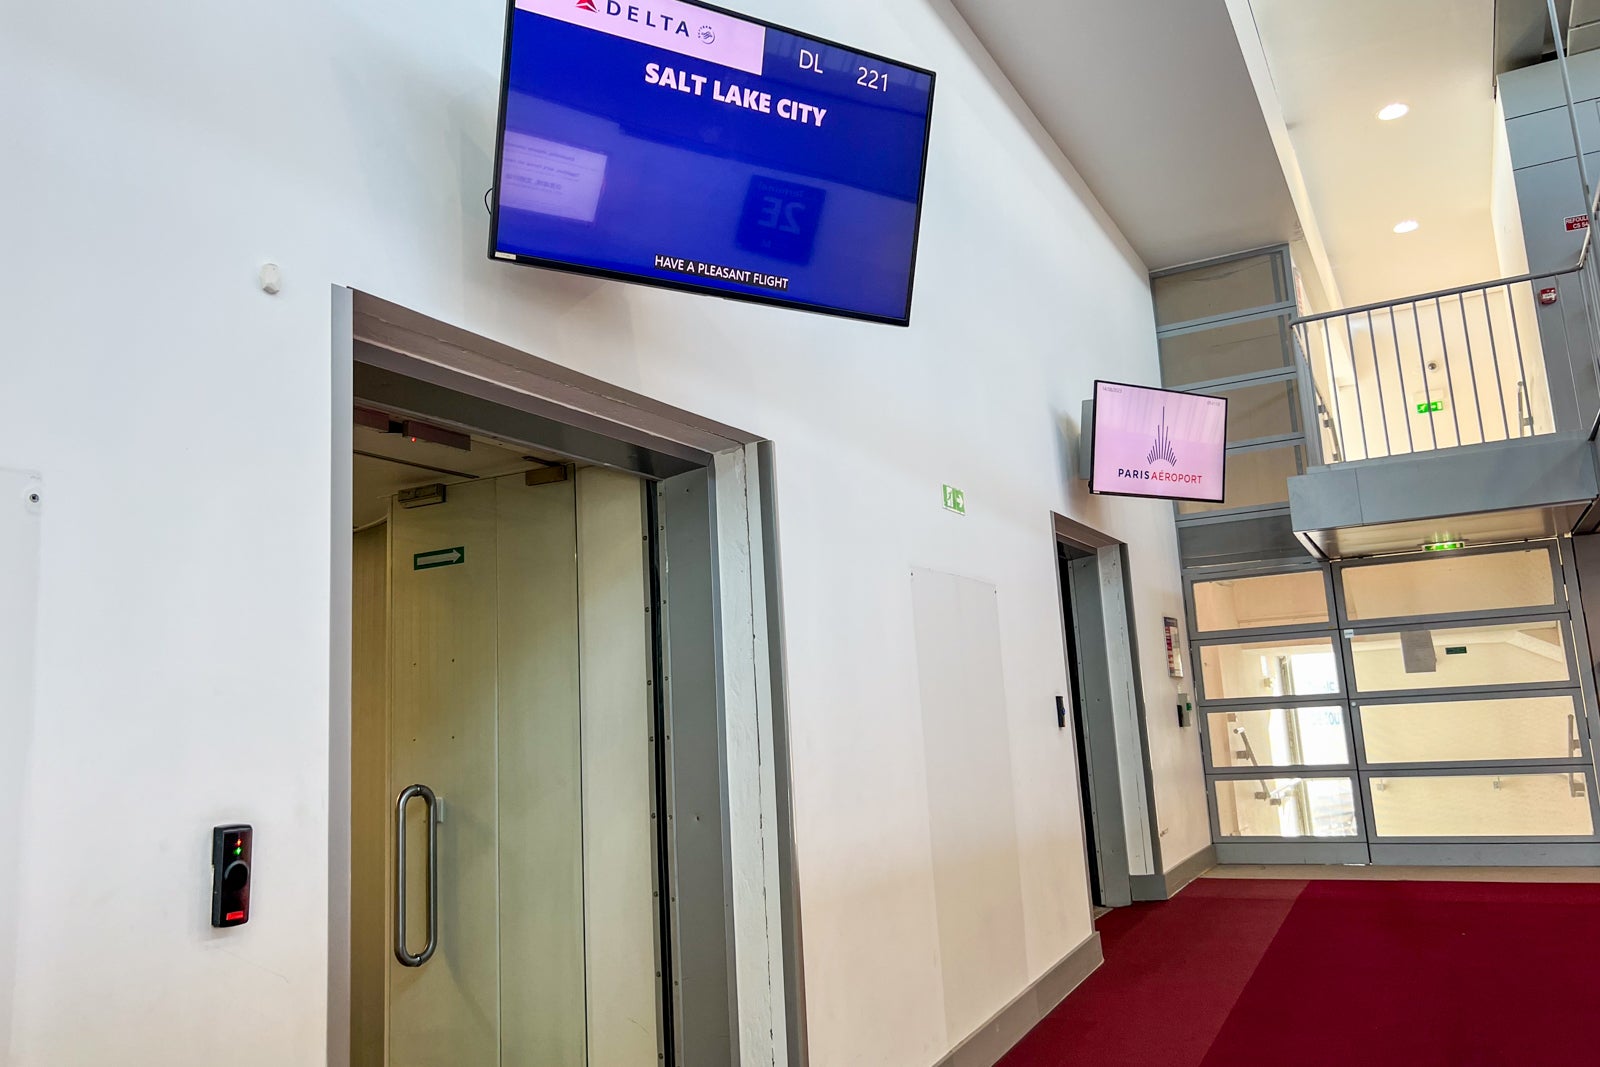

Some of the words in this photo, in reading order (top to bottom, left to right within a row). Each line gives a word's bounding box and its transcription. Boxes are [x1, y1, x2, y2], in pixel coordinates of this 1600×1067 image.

[606, 0, 690, 38] DELTA
[799, 49, 824, 74] DL
[856, 66, 889, 92] 221
[644, 62, 707, 96] SALT
[712, 80, 771, 114] LAKE
[776, 98, 827, 127] CITY
[654, 255, 685, 271] HAVE
[686, 261, 695, 273] A
[697, 263, 751, 282] PLEASANT
[753, 273, 789, 289] FLIGHT
